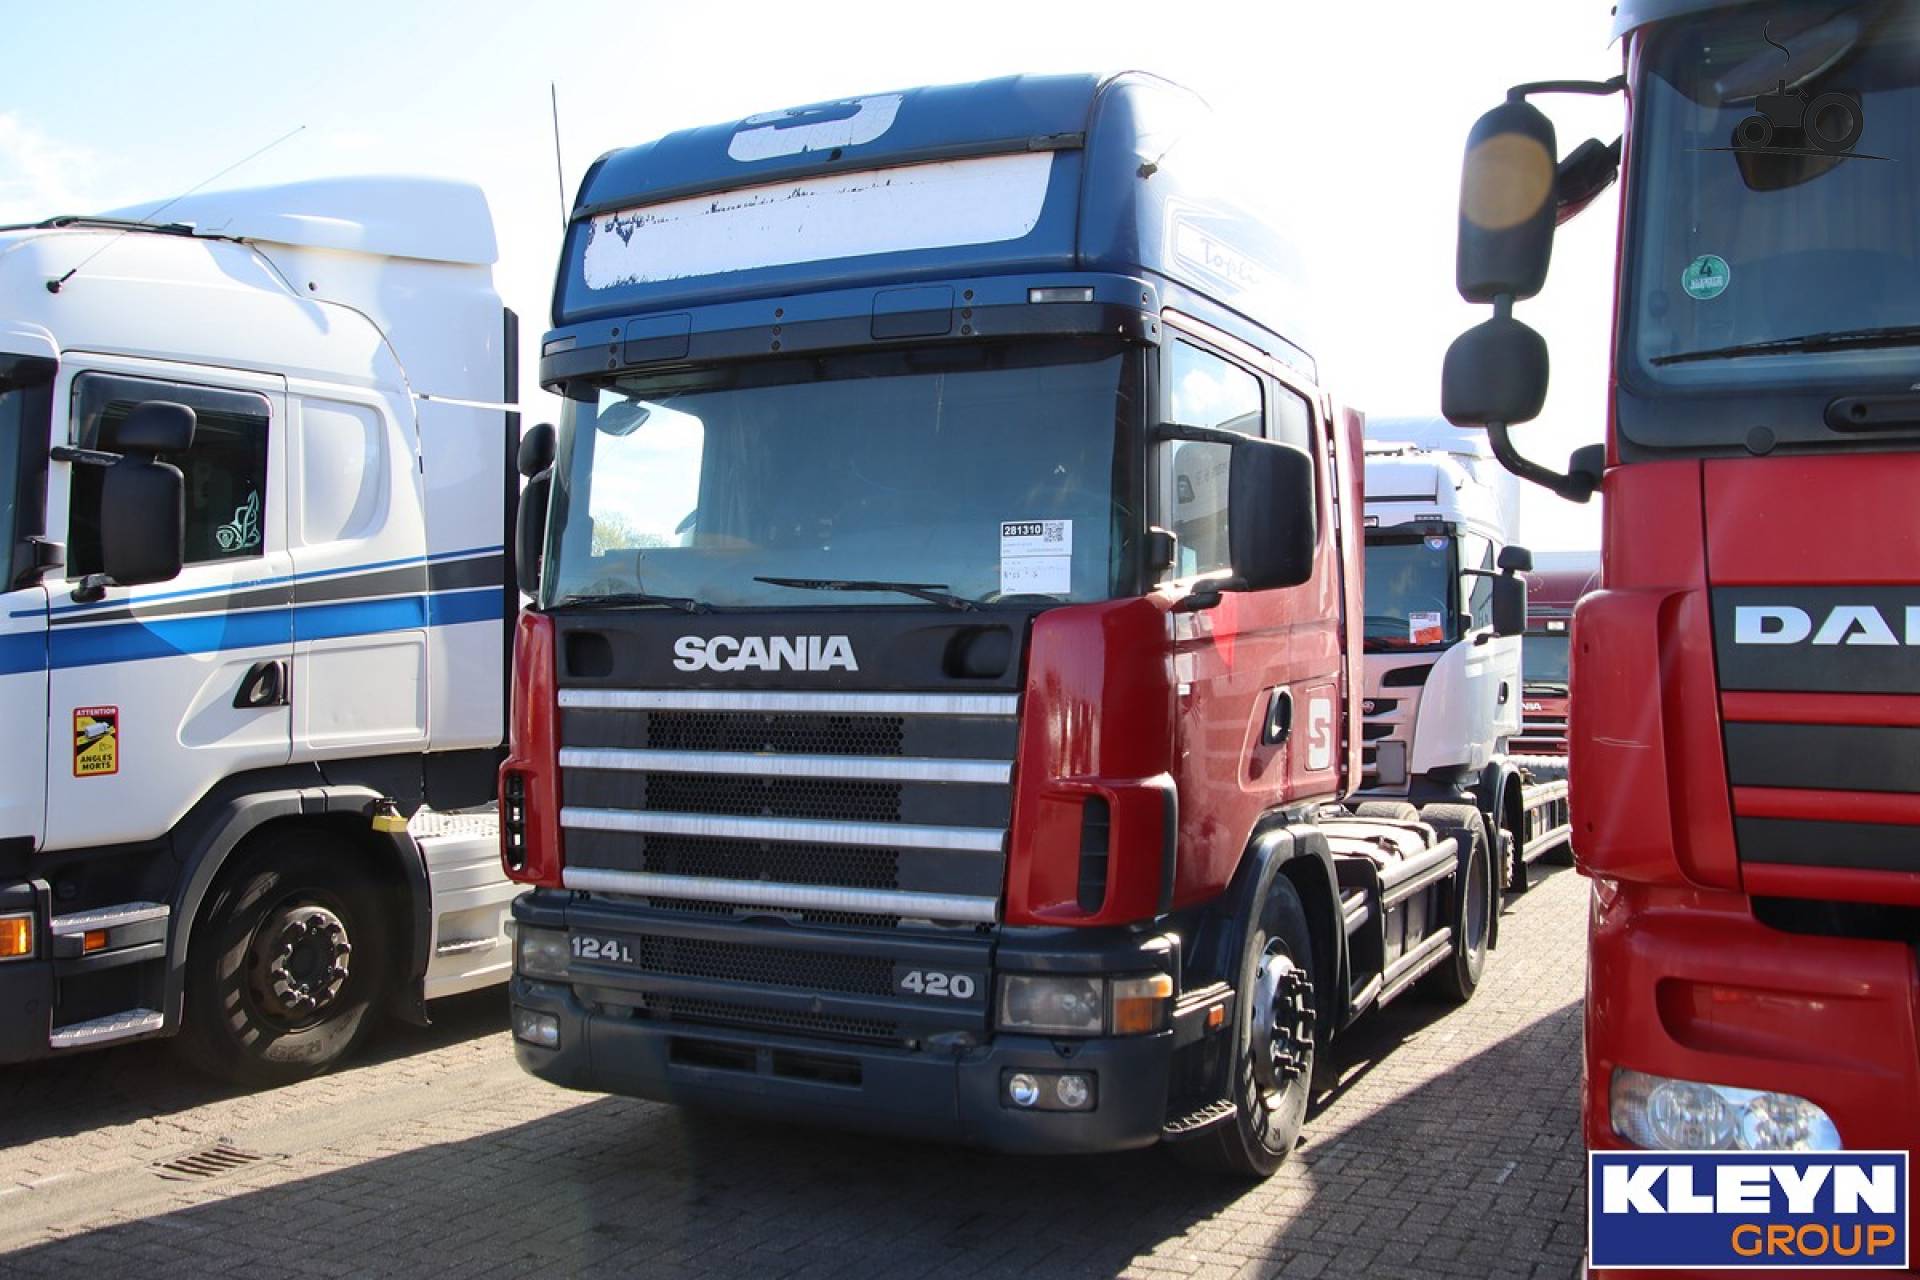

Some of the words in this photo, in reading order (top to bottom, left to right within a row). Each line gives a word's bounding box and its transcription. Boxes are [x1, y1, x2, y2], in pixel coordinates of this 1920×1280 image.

[1700, 257, 1712, 277] 4
[1004, 524, 1041, 535] 281310
[673, 635, 859, 672] SCANIA
[77, 708, 115, 716] ATTENTION
[80, 754, 113, 763] ANGLES
[82, 762, 111, 771] MORTS
[901, 970, 975, 999] 420
